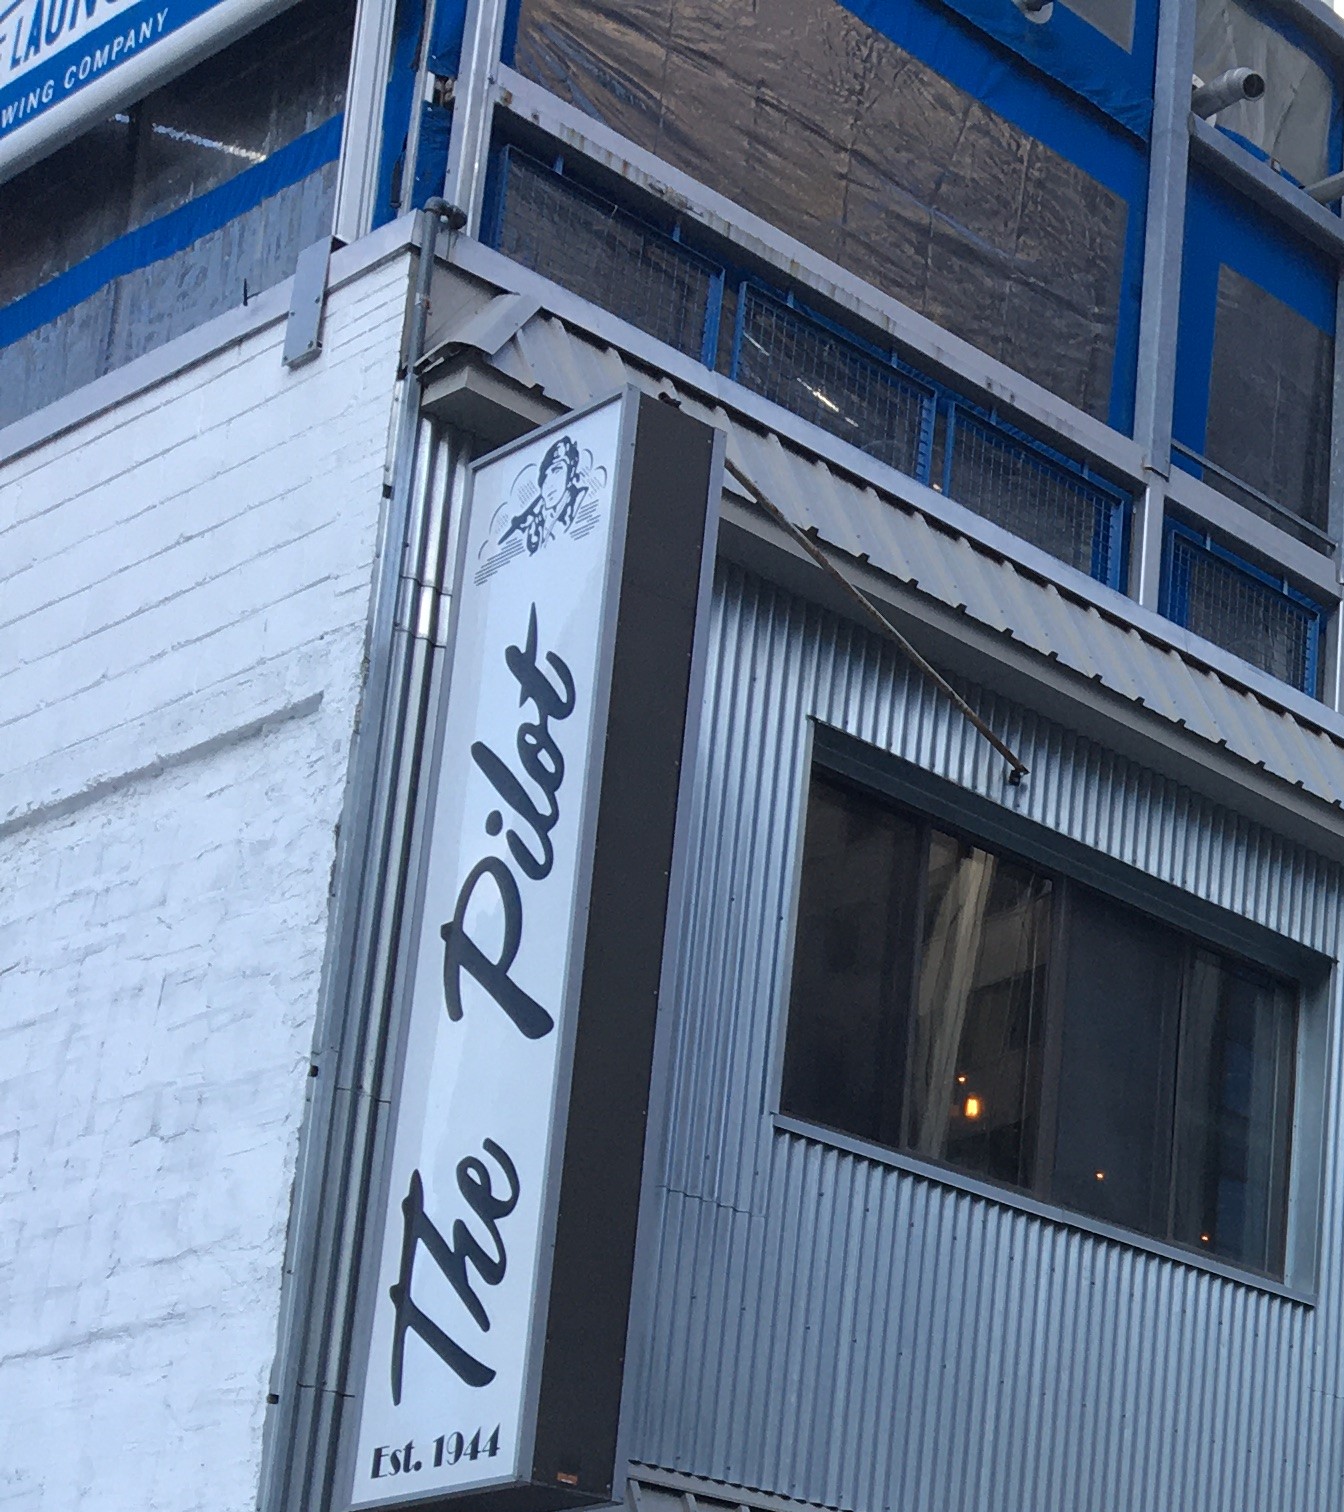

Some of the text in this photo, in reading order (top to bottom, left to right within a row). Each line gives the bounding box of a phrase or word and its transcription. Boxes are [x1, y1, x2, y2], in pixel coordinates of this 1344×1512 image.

[64, 7, 169, 90] COMPANY
[389, 601, 577, 1405] The Pilot
[370, 1421, 502, 1481] Est. 1944
